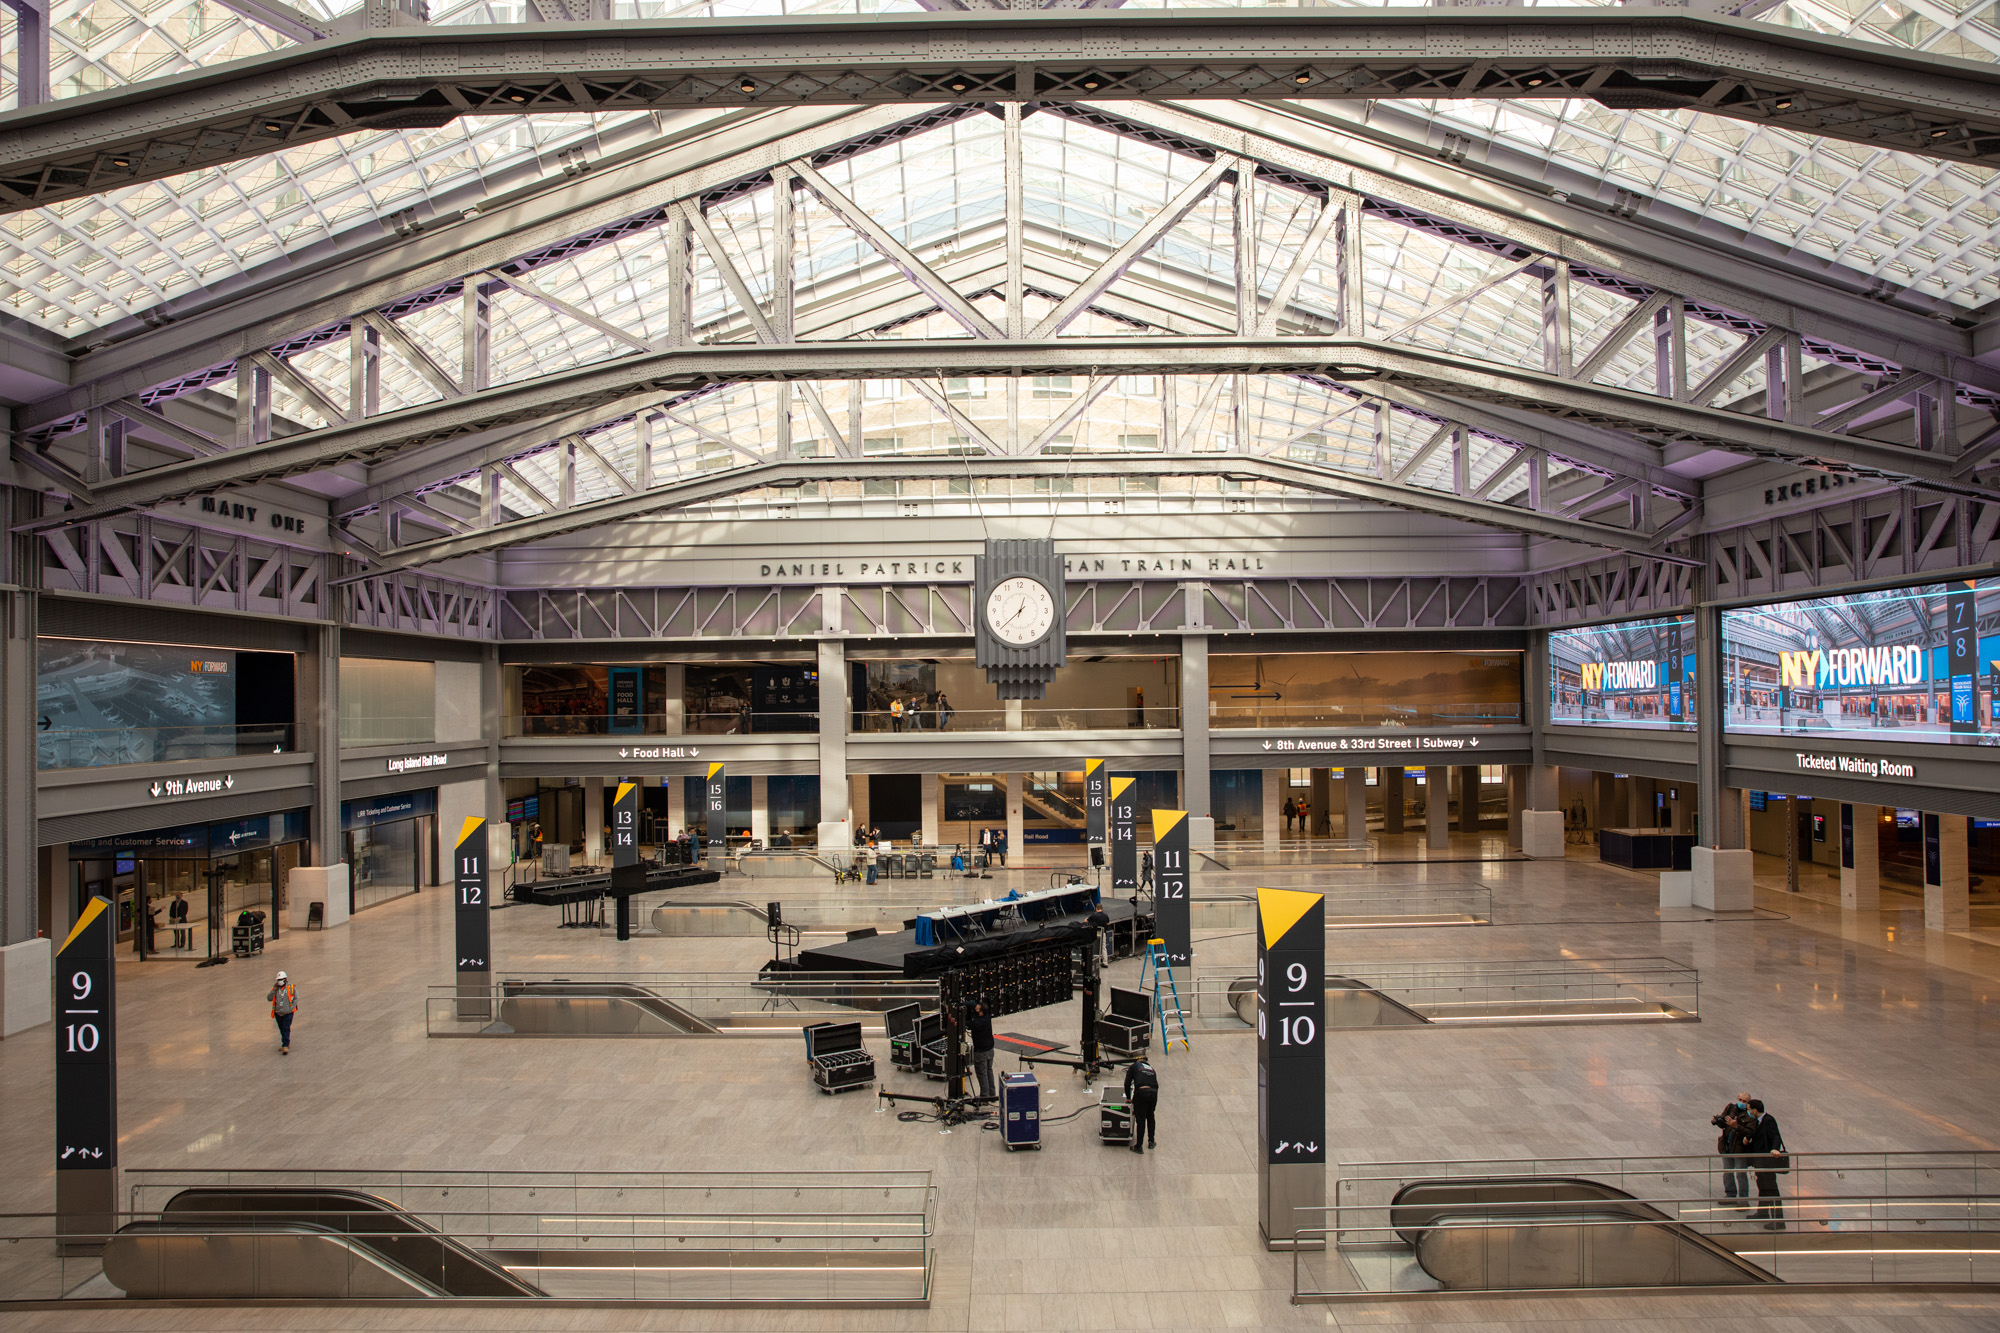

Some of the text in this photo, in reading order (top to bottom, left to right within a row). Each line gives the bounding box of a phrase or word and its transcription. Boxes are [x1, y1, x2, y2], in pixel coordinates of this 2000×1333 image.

[202, 496, 304, 534] MANY ONE
[761, 564, 844, 576] DANIEL
[860, 562, 962, 574] PATRICK
[1122, 558, 1192, 571] TRAIN
[1209, 558, 1264, 570] HALL
[1954, 602, 1965, 624] 7
[1671, 631, 1676, 646] 7
[1956, 638, 1966, 657] 8
[191, 660, 227, 672] NY FORWARD
[1672, 656, 1677, 670] 8
[1780, 645, 1922, 686] NY FORWARD
[1581, 663, 1603, 690] NY
[1608, 660, 1656, 689] FORWARD
[1277, 738, 1464, 750] 8th Avenue & 33rd Street Subway
[633, 748, 684, 758] Food Hall
[388, 754, 447, 772] Long Island Rail Road
[1796, 754, 1914, 777] Ticketed Waiting Room
[166, 778, 222, 796] 9th Avenue
[711, 784, 721, 794] 15
[1091, 781, 1102, 790] 15
[711, 801, 722, 811] 16
[1091, 797, 1102, 807] 16
[618, 811, 632, 824] 13
[1117, 806, 1132, 818] 13
[69, 837, 185, 847] keting and Customer Service
[617, 833, 632, 845] 14
[1117, 828, 1133, 840] 14
[462, 857, 479, 874] 11
[1164, 851, 1181, 868] 11
[461, 887, 481, 904] 12
[1163, 881, 1184, 899] 12
[1259, 958, 1264, 986] 9
[1286, 963, 1308, 992] 9
[72, 971, 92, 1000] 9
[1258, 1008, 1266, 1040] 10
[1279, 1016, 1315, 1046] 10
[65, 1023, 99, 1052] 10
